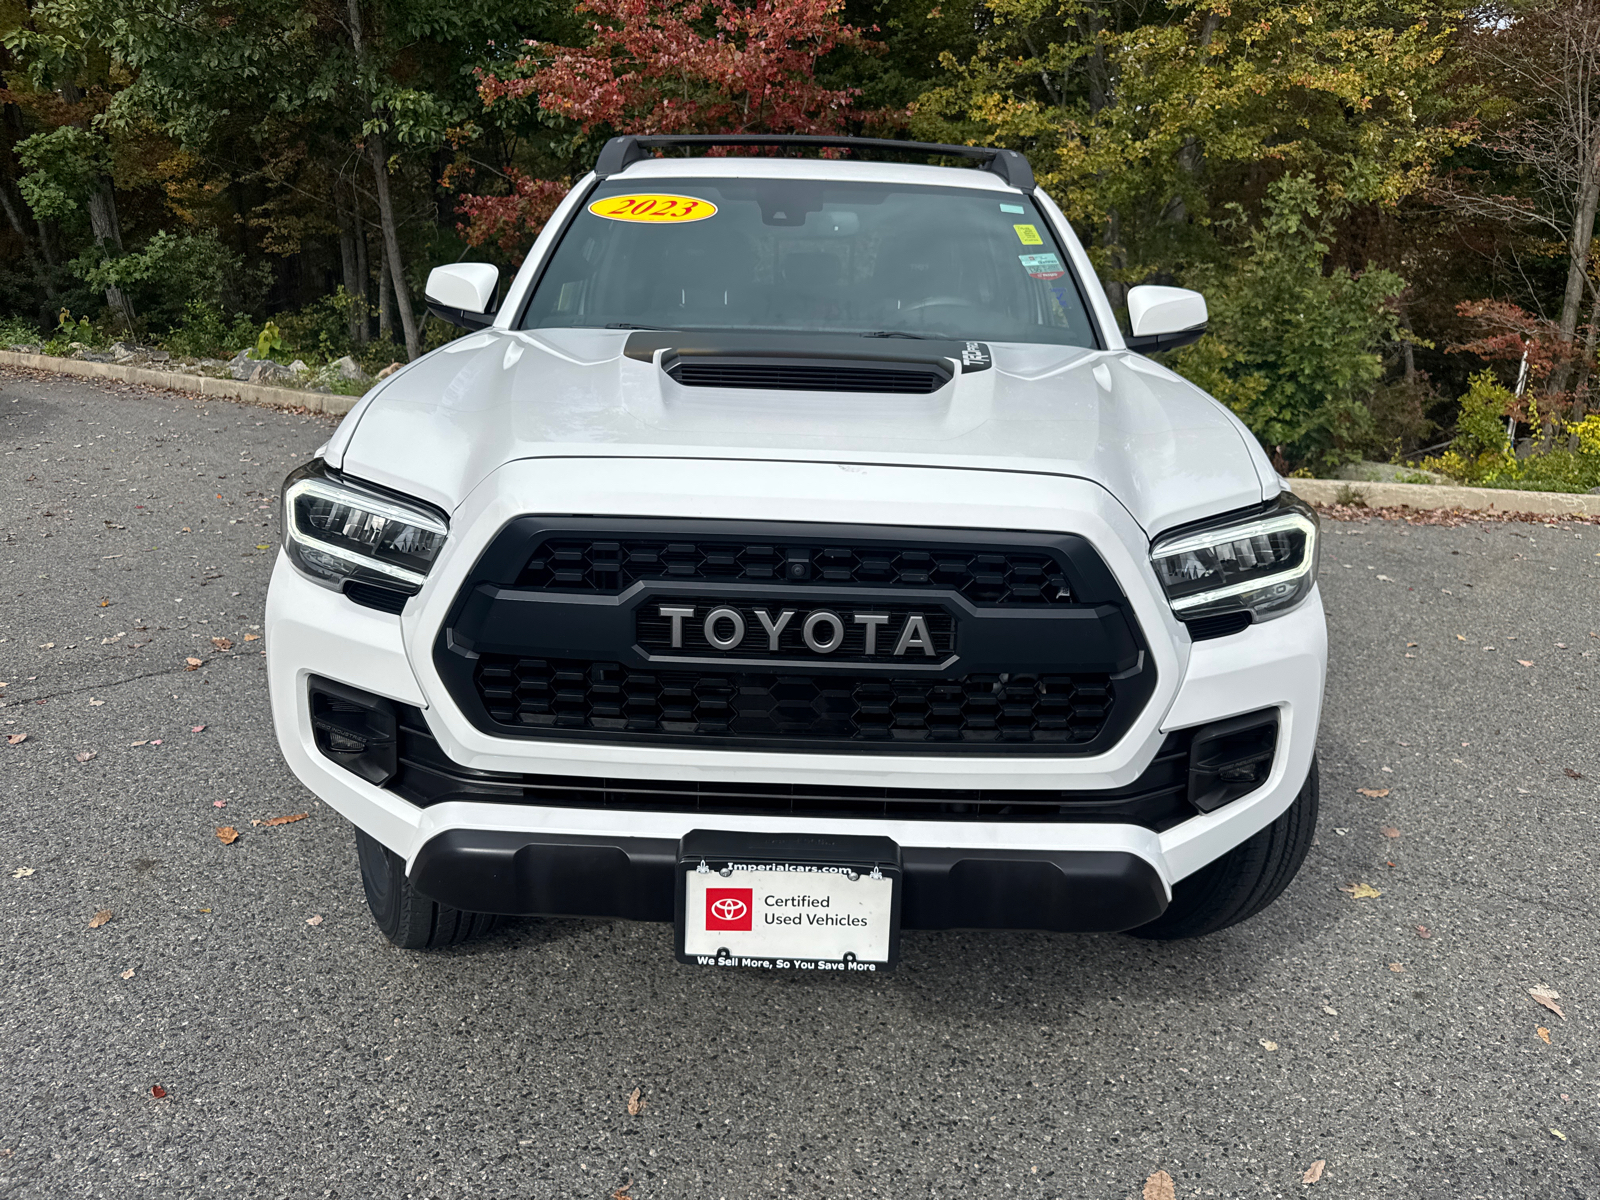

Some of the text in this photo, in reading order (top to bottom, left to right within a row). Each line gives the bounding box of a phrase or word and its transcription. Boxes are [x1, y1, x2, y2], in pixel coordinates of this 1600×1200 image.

[607, 199, 699, 217] 2023
[659, 607, 936, 656] TOYOTA
[727, 863, 852, 875] Imperialcars.com
[764, 895, 830, 908] Certified
[764, 912, 868, 927] Used Vehicles
[697, 956, 876, 972] We Sell More, So You Save More
